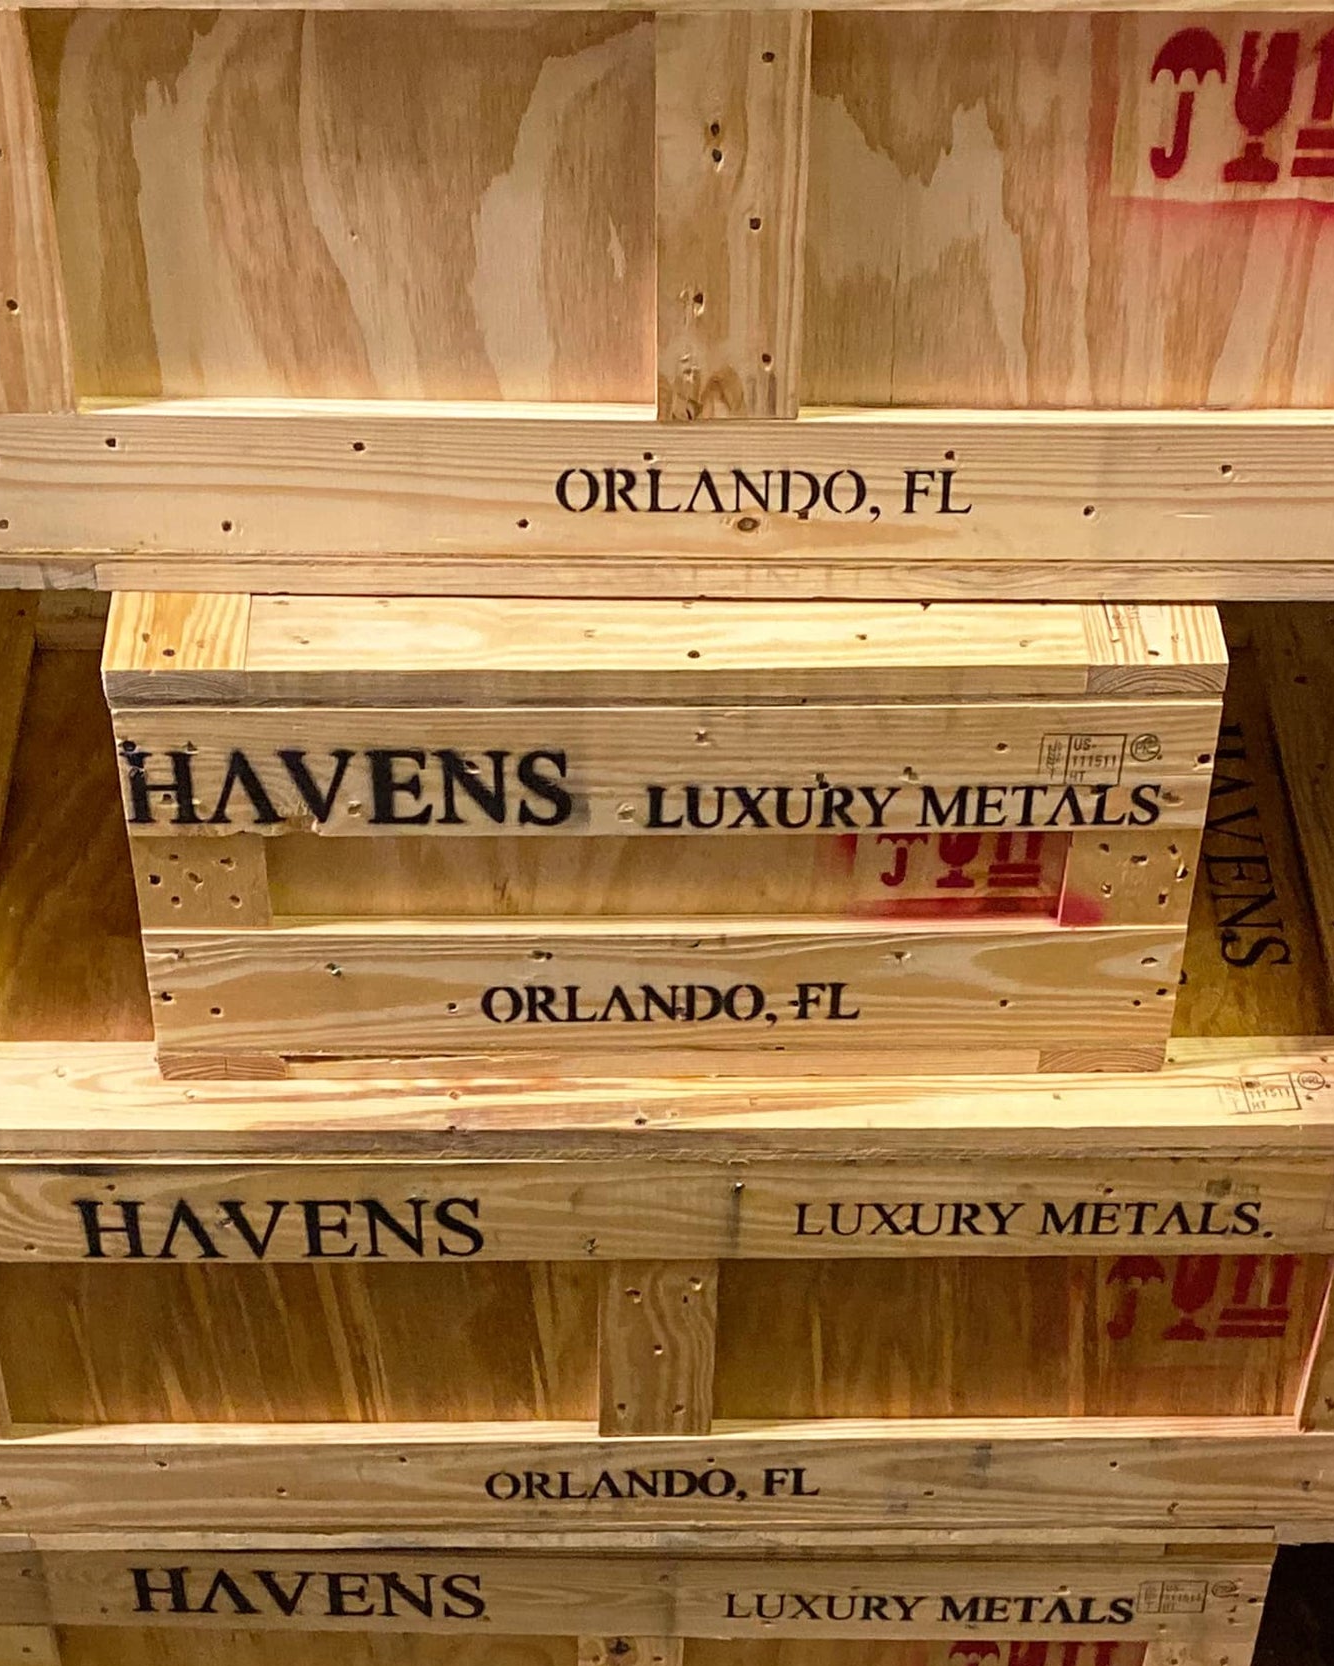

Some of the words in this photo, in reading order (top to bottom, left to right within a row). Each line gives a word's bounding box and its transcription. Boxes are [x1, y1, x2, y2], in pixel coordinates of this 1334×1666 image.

[555, 468, 881, 521] ORLANDO,
[903, 469, 973, 516] FL
[119, 750, 575, 827] HAVENS
[645, 786, 904, 830] LUXURY
[916, 783, 1163, 828] METALS
[480, 984, 778, 1026] ORLANDO,
[798, 982, 860, 1021] FL
[72, 1197, 485, 1260] HAVENS
[793, 1202, 1026, 1237] LUXURY
[484, 1467, 749, 1502] ORLANDO,
[762, 1467, 821, 1497] FL
[127, 1566, 486, 1620] HAVENS
[724, 1592, 922, 1622] LUXURY
[939, 1594, 1134, 1625] METALS
